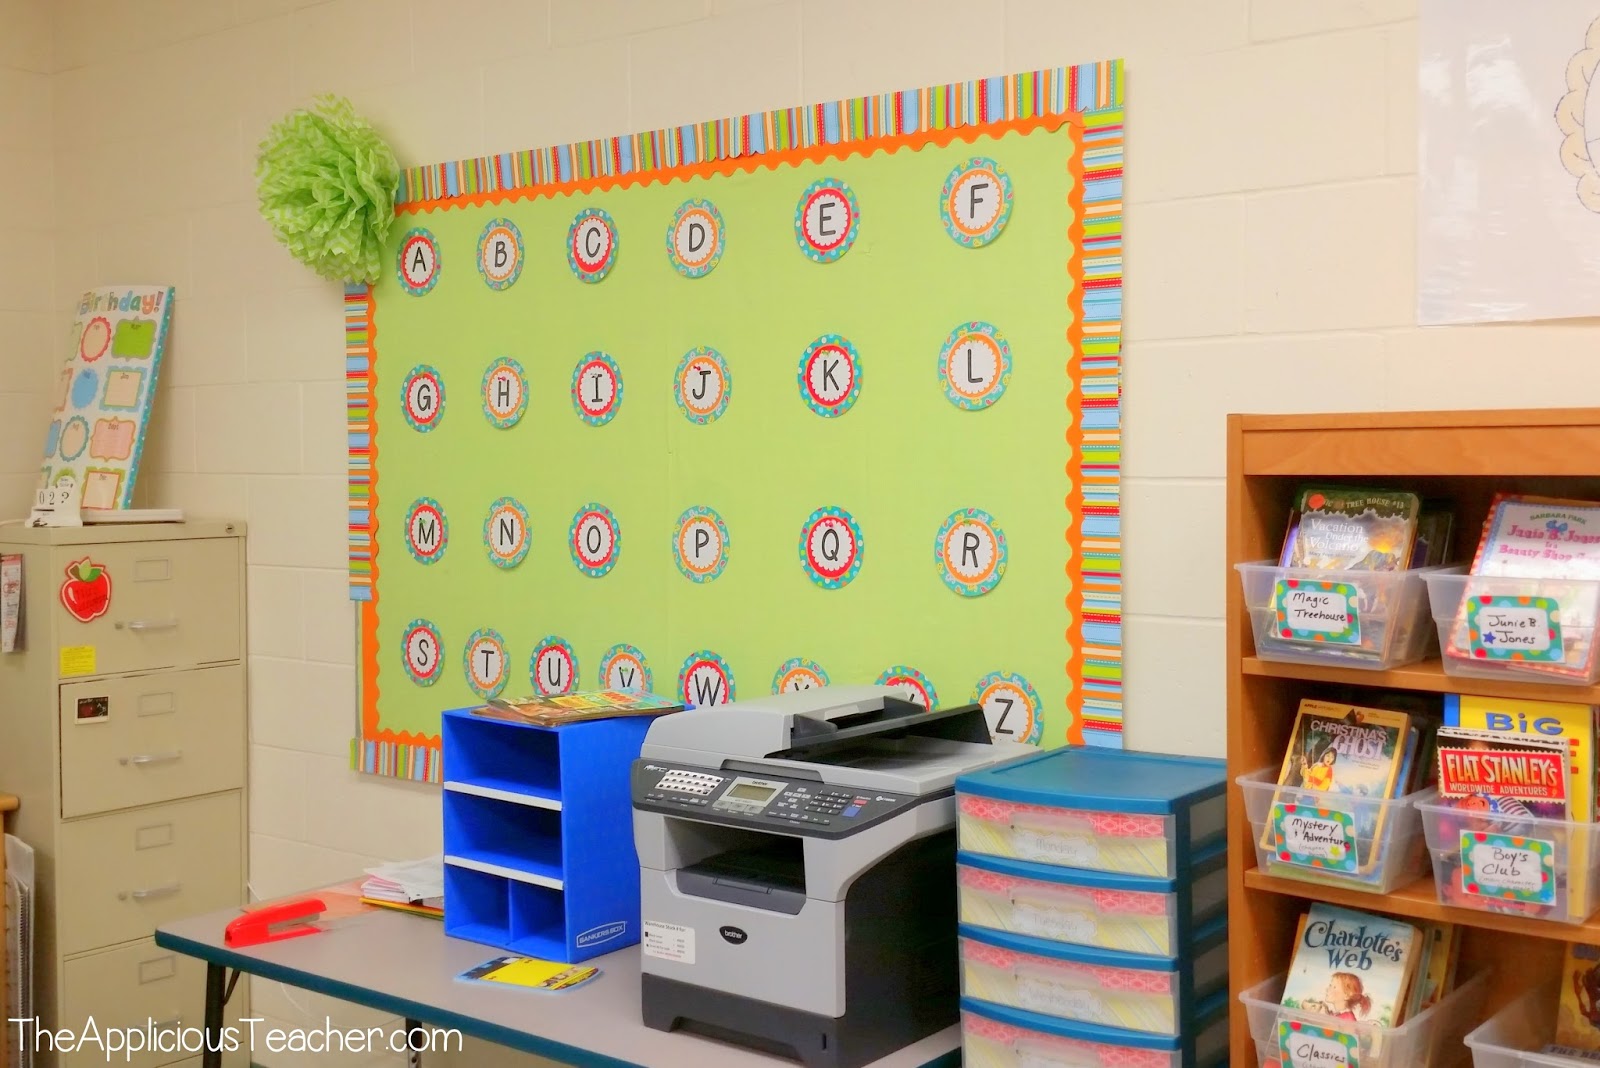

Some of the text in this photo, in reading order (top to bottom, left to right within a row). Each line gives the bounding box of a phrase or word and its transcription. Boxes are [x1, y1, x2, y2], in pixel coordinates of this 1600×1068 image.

[412, 183, 989, 273] A B C D E F
[417, 348, 984, 412] G H I J K L
[1346, 499, 1364, 508] TREE
[1366, 498, 1390, 506] HOUSE
[1310, 518, 1364, 534] Vacation
[1530, 512, 1566, 521] BARBARA
[418, 518, 980, 568] M N O P Q R
[1310, 536, 1360, 552] Volcano
[1292, 592, 1329, 608] Magic
[1294, 608, 1346, 622] Treehouse
[1487, 614, 1526, 628] Junie
[1495, 630, 1536, 644] Jones
[417, 638, 1015, 735] S T U V W Z
[1310, 720, 1388, 742] CHRISTINA'S
[1332, 734, 1387, 760] GHOST
[1445, 754, 1480, 782] FLAT
[1449, 782, 1495, 794] WORLDWIDE
[1500, 786, 1548, 797] ADVENTURES
[1292, 818, 1339, 836] Mystery
[1492, 846, 1529, 868] Boy's
[1482, 863, 1521, 876] Club
[580, 924, 624, 944] BANKERS BOX
[724, 929, 742, 939] brother
[1304, 918, 1404, 963] Charlotte's
[1326, 948, 1373, 971] Web
[1296, 1043, 1346, 1063] Classics
